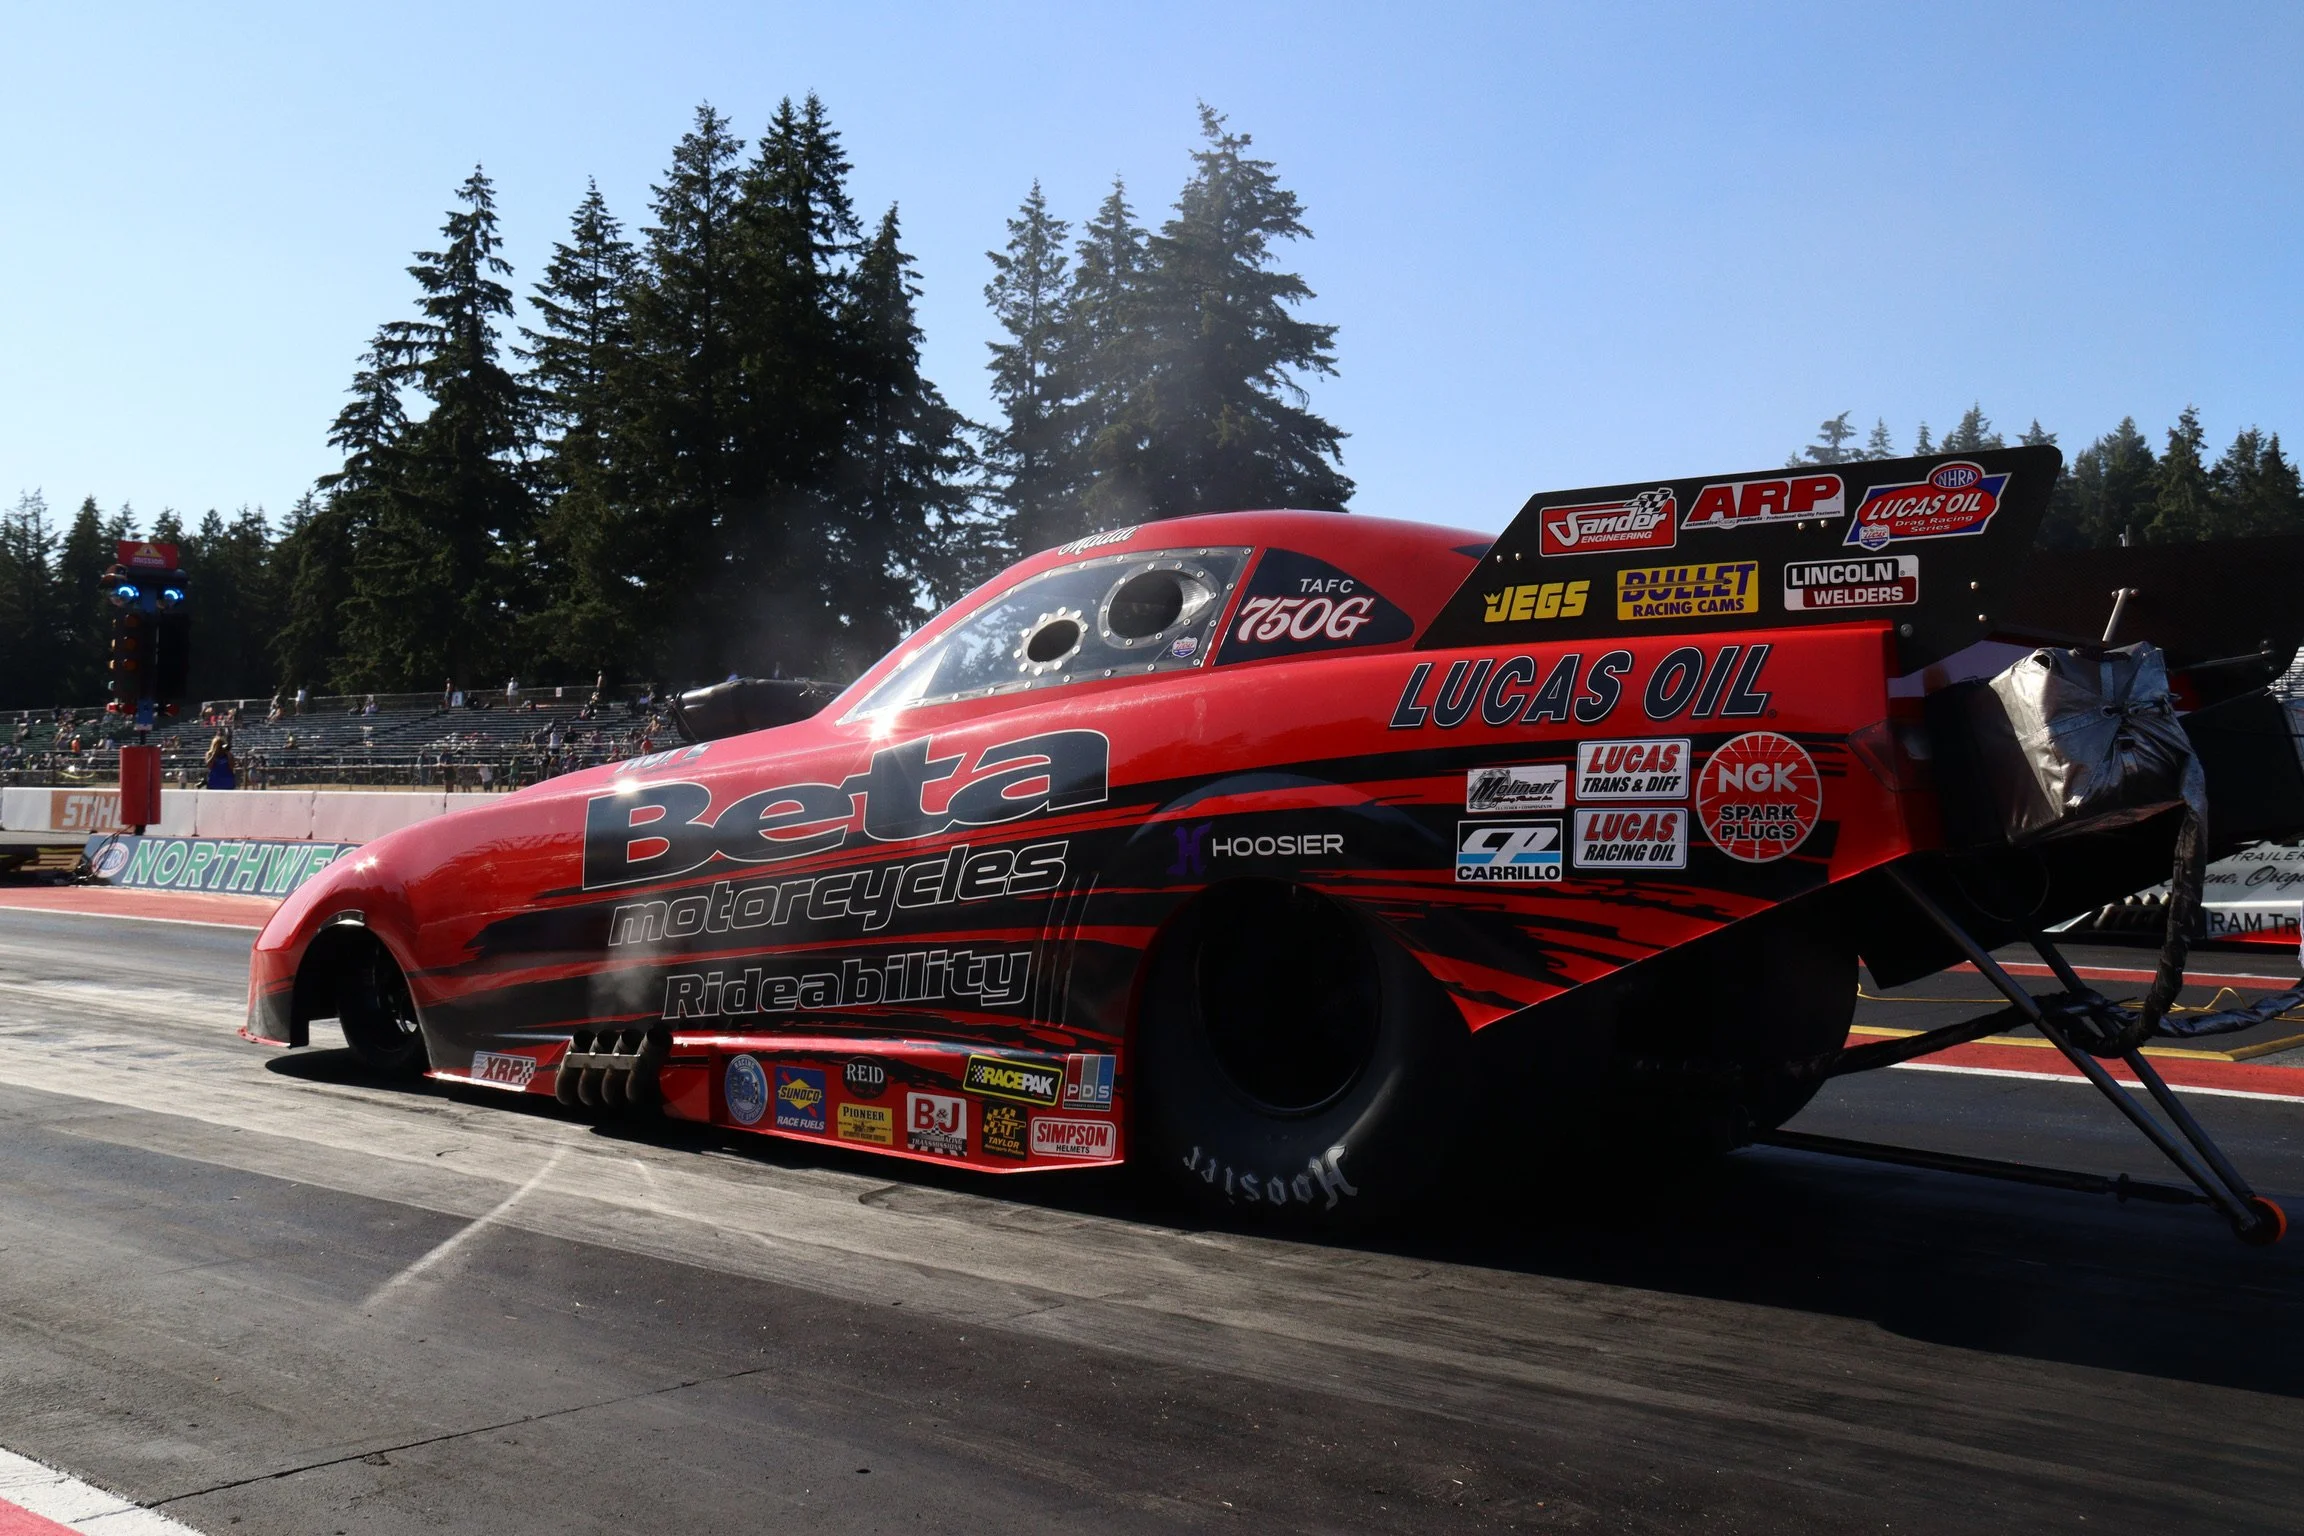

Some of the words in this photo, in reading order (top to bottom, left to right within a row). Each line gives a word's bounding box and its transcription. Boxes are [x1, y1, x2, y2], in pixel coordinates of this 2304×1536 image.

[1938, 470, 1974, 487] NHRA
[1687, 476, 1841, 522] ARP
[1866, 494, 1946, 521] LUCAS
[1945, 492, 1983, 513] OIL
[1547, 507, 1668, 546] Sander
[1895, 519, 1925, 527] Drag
[1929, 515, 1973, 524] Racing
[1910, 524, 1950, 533] Series
[1581, 531, 1653, 544] ENGINEERING
[1621, 563, 1756, 603] BULLET
[1791, 562, 1893, 586] LINCOLN
[1300, 578, 1354, 594] TAFC
[1813, 586, 1904, 605] WELDERS
[1484, 579, 1591, 623] JEGS
[1632, 601, 1692, 617] RACING
[1697, 598, 1744, 613] CAMS
[1237, 596, 1376, 643] 750G
[1389, 650, 1633, 729] LUCAS
[1643, 644, 1774, 721] OIL
[1586, 743, 1682, 774] LUCAS
[1582, 776, 1632, 793] TRANS
[1632, 776, 1643, 792] &
[1645, 775, 1682, 792] DIFF
[1718, 761, 1798, 794] NGK
[582, 728, 1109, 891] Beta
[1720, 804, 1798, 821] SPARK
[1583, 813, 1679, 842] LUCAS
[1720, 824, 1797, 841] PLUGS
[1212, 833, 1345, 857] HOOSIER
[1583, 844, 1644, 861] RACING
[1648, 844, 1677, 861] OIL
[1457, 865, 1561, 880] CARRILLO
[608, 840, 1070, 946] motorcycles
[2210, 912, 2263, 932] RAM
[2268, 912, 2301, 935] TR
[662, 950, 1032, 1020] Rideability
[482, 1056, 525, 1083] XRP
[846, 1063, 885, 1083] REID
[983, 1067, 1054, 1095] RACEPAK
[780, 1086, 820, 1102] SUNOCO
[1067, 1084, 1110, 1098] PDS
[777, 1115, 799, 1127] RACE
[800, 1118, 825, 1130] FUELS
[843, 1106, 885, 1121] PIONEER
[914, 1098, 960, 1133] B&J
[989, 1136, 1020, 1149] TAYLOR
[1037, 1122, 1109, 1147] SIMPSON
[1056, 1144, 1090, 1154] HELMETS
